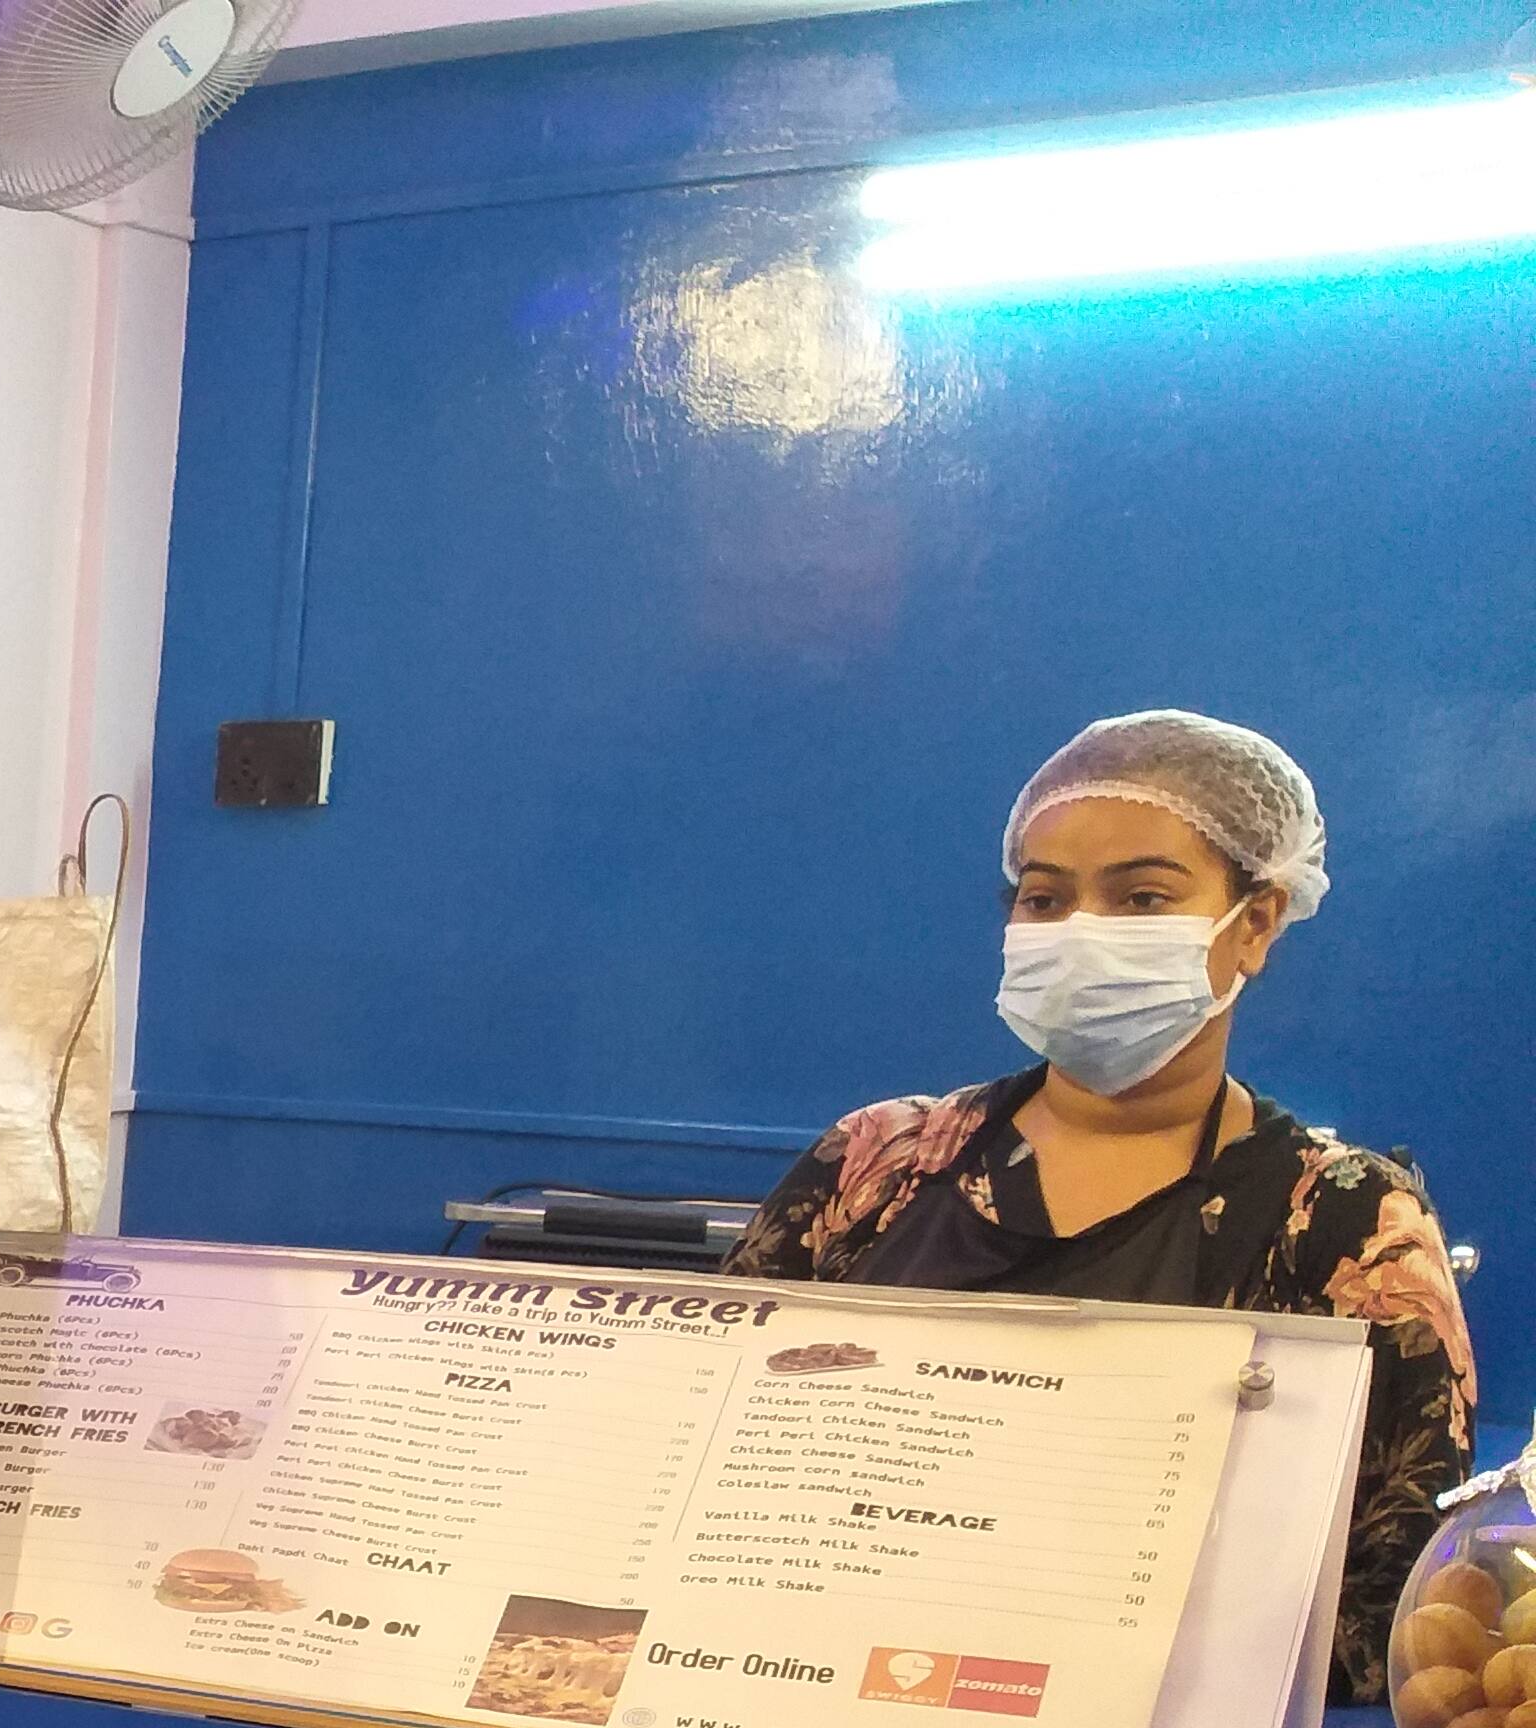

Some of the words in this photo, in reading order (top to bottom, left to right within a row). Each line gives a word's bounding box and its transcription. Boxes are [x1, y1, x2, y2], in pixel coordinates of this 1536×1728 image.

[66, 1295, 165, 1311] PHUCHKA
[373, 1294, 457, 1313] Hungry??
[462, 1300, 501, 1315] Take
[507, 1307, 518, 1318] a
[526, 1307, 558, 1323] trip
[563, 1311, 582, 1323] to
[587, 1311, 647, 1330] Yumm
[569, 1285, 780, 1328] Street
[0, 1311, 50, 1323] Phuchka
[50, 1328, 86, 1338] Magic
[424, 1320, 525, 1343] CHICKEN
[539, 1331, 617, 1349] WINGS
[445, 1372, 512, 1392] PIZZA
[915, 1360, 1064, 1392] SANDWICH
[754, 1379, 789, 1390] Corn
[798, 1381, 852, 1391] Cheese
[861, 1383, 935, 1401] Sandwich
[80, 1408, 137, 1424] WITH
[748, 1396, 810, 1407] Chicken
[820, 1399, 855, 1408] Corn
[864, 1401, 920, 1416] Cheese
[929, 1410, 1005, 1427] Sandwich
[70, 1428, 129, 1443] FRIES
[743, 1412, 812, 1423] Tandoori
[822, 1415, 886, 1429] Chicken
[896, 1423, 970, 1441] Sandwich
[20, 1446, 67, 1458] Burger
[736, 1429, 770, 1439] Peri
[780, 1431, 815, 1440] Peri
[825, 1432, 890, 1447] Chicken
[900, 1441, 974, 1458] Sandwich
[730, 1445, 792, 1456] Chicken
[801, 1448, 856, 1459] Cheese
[865, 1454, 940, 1472] Sandwich
[4, 1463, 50, 1476] Burger
[723, 1462, 795, 1472] Mushroom
[804, 1466, 841, 1475] corn
[850, 1470, 925, 1488] sandwich
[717, 1479, 790, 1490] Coleslaw
[798, 1483, 872, 1498] sandwich
[29, 1504, 81, 1519] FRIES
[705, 1511, 769, 1522] Vanilla
[778, 1513, 817, 1525] Milk
[828, 1517, 877, 1532] Shake
[850, 1502, 998, 1531] BEVERAGE
[696, 1532, 810, 1546] Butterscotch
[819, 1538, 859, 1551] Milk
[869, 1543, 920, 1558] Shake
[272, 1546, 306, 1558] Papdi
[314, 1552, 348, 1566] Chaat
[367, 1552, 451, 1576] CHAAT
[688, 1553, 774, 1566] Chocolate
[782, 1557, 822, 1569] Milk
[832, 1561, 882, 1576] Shake
[1138, 1551, 1158, 1561] 50
[680, 1575, 718, 1584] Oreo
[726, 1576, 765, 1588] Milk
[775, 1579, 825, 1593] Shake
[1131, 1571, 1152, 1583] 50
[1124, 1594, 1145, 1606] 50
[194, 1616, 228, 1626] Extra
[234, 1620, 275, 1631] Cheese
[281, 1626, 296, 1634] on
[303, 1629, 359, 1646] Sandwich
[315, 1609, 370, 1630] ADD
[384, 1621, 421, 1638] ON
[189, 1630, 223, 1638] Extra
[230, 1632, 270, 1643] Cheese
[297, 1642, 332, 1656] Pizza
[647, 1642, 734, 1672] Order
[742, 1653, 835, 1685] Online
[954, 1677, 1042, 1697] zomato
[864, 1691, 941, 1706] SWIGGY
